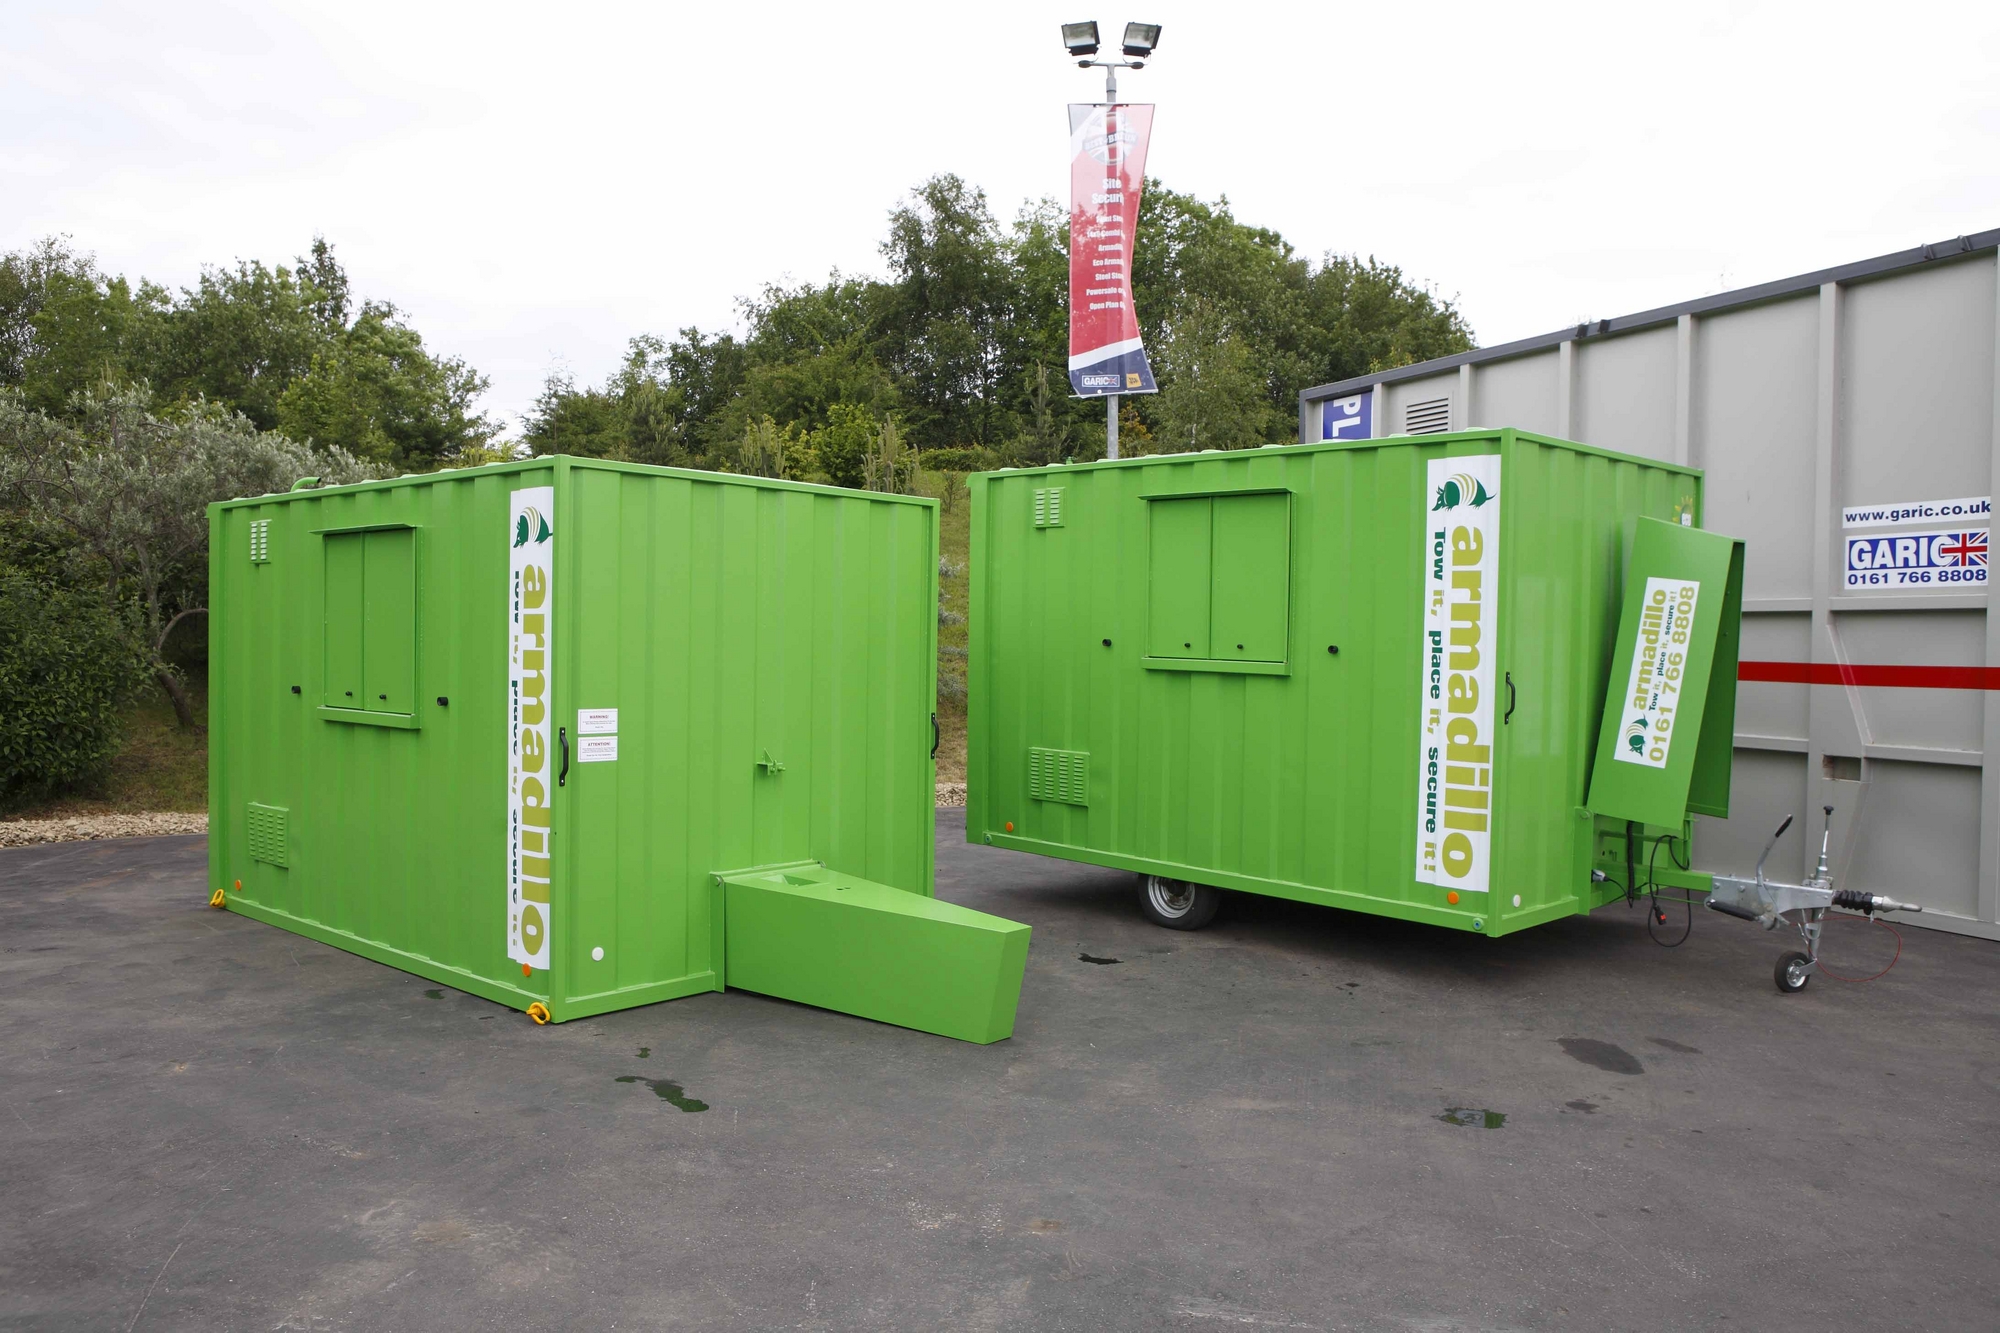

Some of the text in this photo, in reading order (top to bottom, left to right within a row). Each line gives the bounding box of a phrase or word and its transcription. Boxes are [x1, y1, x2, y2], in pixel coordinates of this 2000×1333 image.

[1102, 178, 1121, 189] Site
[1095, 272, 1111, 280] Steel
[1090, 302, 1105, 310] Open
[1084, 377, 1109, 386] GARIC
[1845, 500, 1991, 523] www.garic.co.uk
[1850, 534, 1955, 570] GARIC
[1848, 569, 1987, 585] 0161 766 8808
[1633, 589, 1667, 711] armadillo
[1648, 692, 1659, 711] Tow
[1657, 651, 1667, 677] place
[1664, 604, 1675, 635] secure
[1649, 586, 1695, 762] 0161 766 8808
[1424, 526, 1446, 873] Tow it, place it, secure it!
[1441, 525, 1490, 878] armadillo
[521, 564, 551, 956] armadillo
